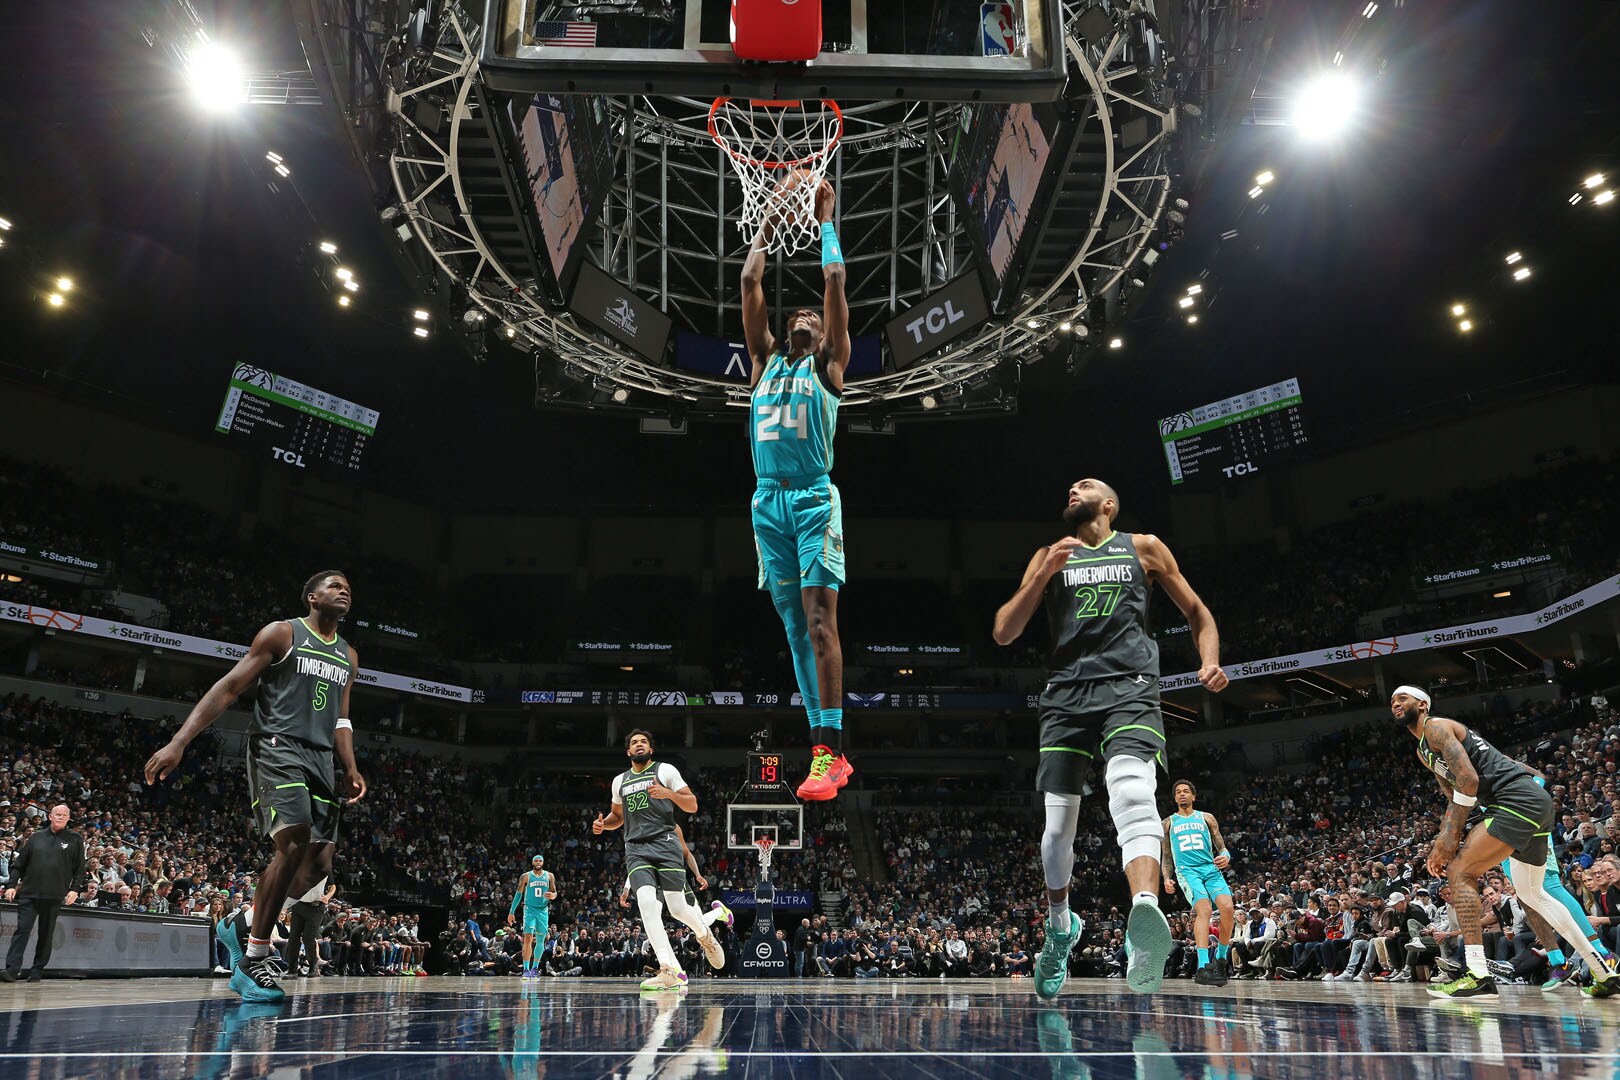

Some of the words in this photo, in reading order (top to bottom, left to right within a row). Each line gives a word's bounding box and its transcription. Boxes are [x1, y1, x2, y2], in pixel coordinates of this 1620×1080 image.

[906, 300, 965, 344] TCL
[785, 376, 815, 397] CITY
[240, 402, 264, 414] Edwards
[243, 394, 270, 408] McDaniels
[235, 417, 254, 427] Gobert
[238, 410, 284, 428] Alexander-Walker
[757, 402, 807, 442] 24
[233, 424, 251, 434] Towns
[1177, 436, 1201, 446] McDaniels
[1179, 445, 1199, 453] Edwards
[1180, 446, 1221, 460] Alexander-Walker
[272, 446, 305, 468] TCL
[1182, 460, 1198, 468] Gobert
[1222, 461, 1258, 478] TCL
[49, 552, 98, 569] StarTribune
[1433, 568, 1480, 582] StarTribune
[1501, 554, 1551, 569] StarTribune
[1062, 565, 1132, 587] TIMBERWOLVES
[1075, 585, 1122, 619] 27
[120, 628, 182, 648] StarTribune
[384, 625, 418, 638] StarTribune
[1159, 675, 1200, 689] StarTribu
[1242, 659, 1299, 675] StarTribune
[1434, 625, 1498, 643] StarTribune
[1544, 598, 1584, 622] StarTribune
[296, 656, 349, 686] TIMBERWOLVES
[84, 692, 99, 700] 136
[313, 681, 329, 711] 5
[418, 683, 462, 698] StarTribune
[522, 691, 554, 703] KFAN
[724, 696, 736, 704] 85
[756, 694, 778, 704] 7:09
[760, 757, 778, 766] 7:09
[762, 766, 776, 782] 19
[627, 792, 648, 812] 32
[1174, 823, 1189, 834] BUZZ
[1190, 822, 1204, 831] CITY
[1178, 834, 1204, 852] 25
[535, 888, 542, 897] 0
[773, 896, 807, 904] ULTRA
